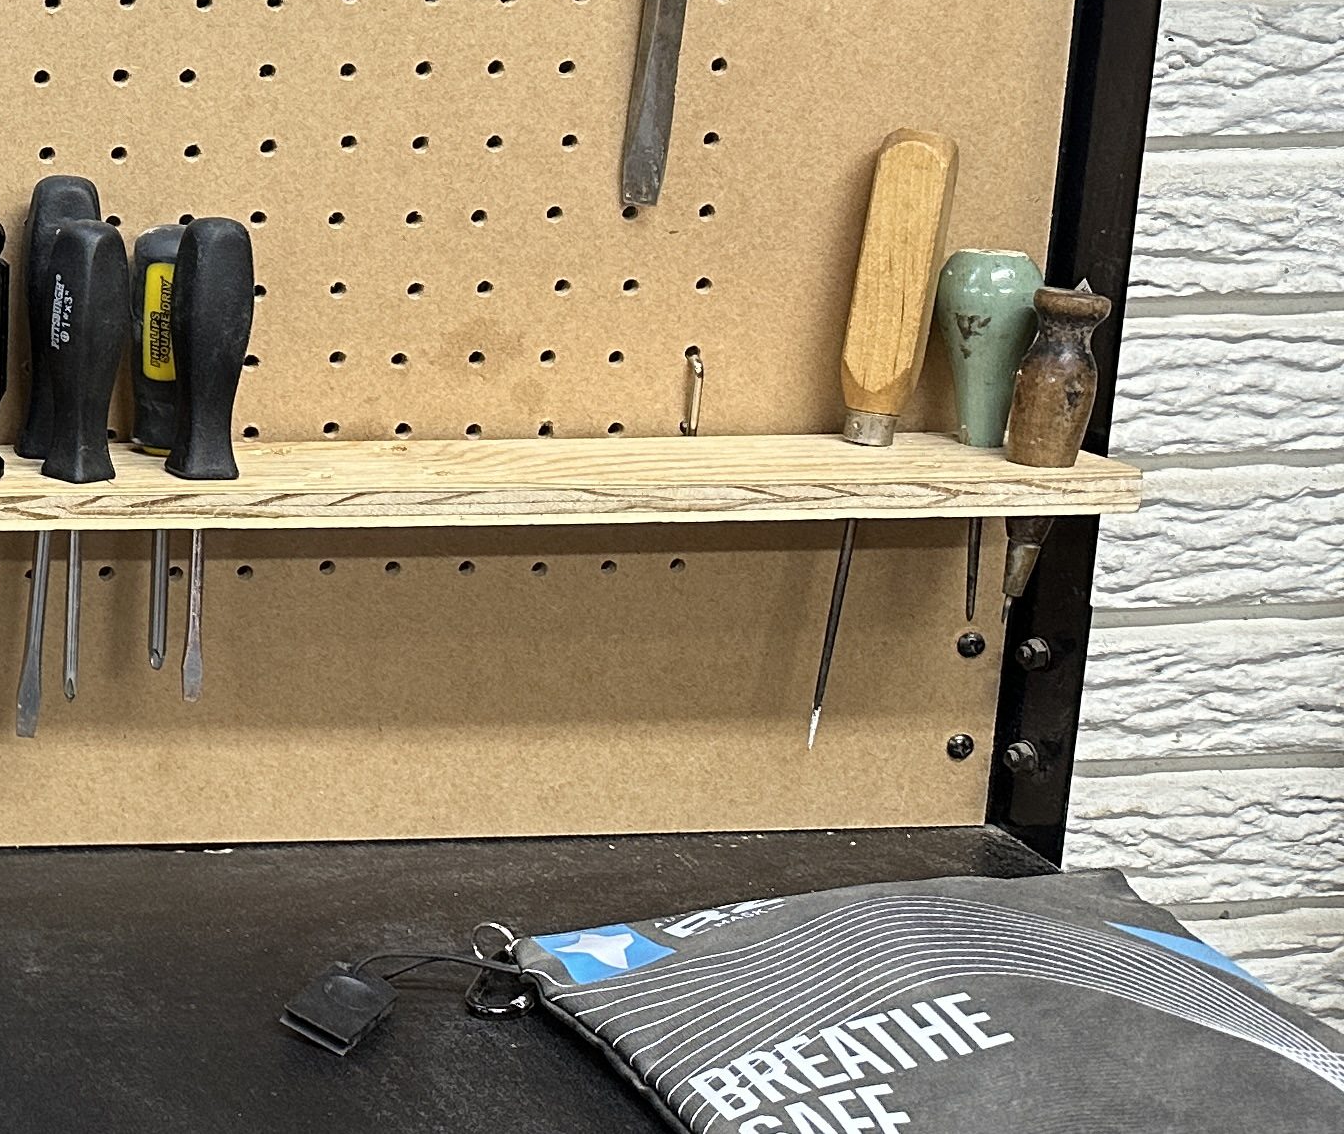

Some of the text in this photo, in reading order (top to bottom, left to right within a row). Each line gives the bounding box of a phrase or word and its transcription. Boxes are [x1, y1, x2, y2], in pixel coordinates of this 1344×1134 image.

[150, 311, 161, 368] PHILLIPS
[714, 908, 769, 928] MASK
[688, 992, 1015, 1121] BREATHE
[738, 1083, 911, 1134] AFE
